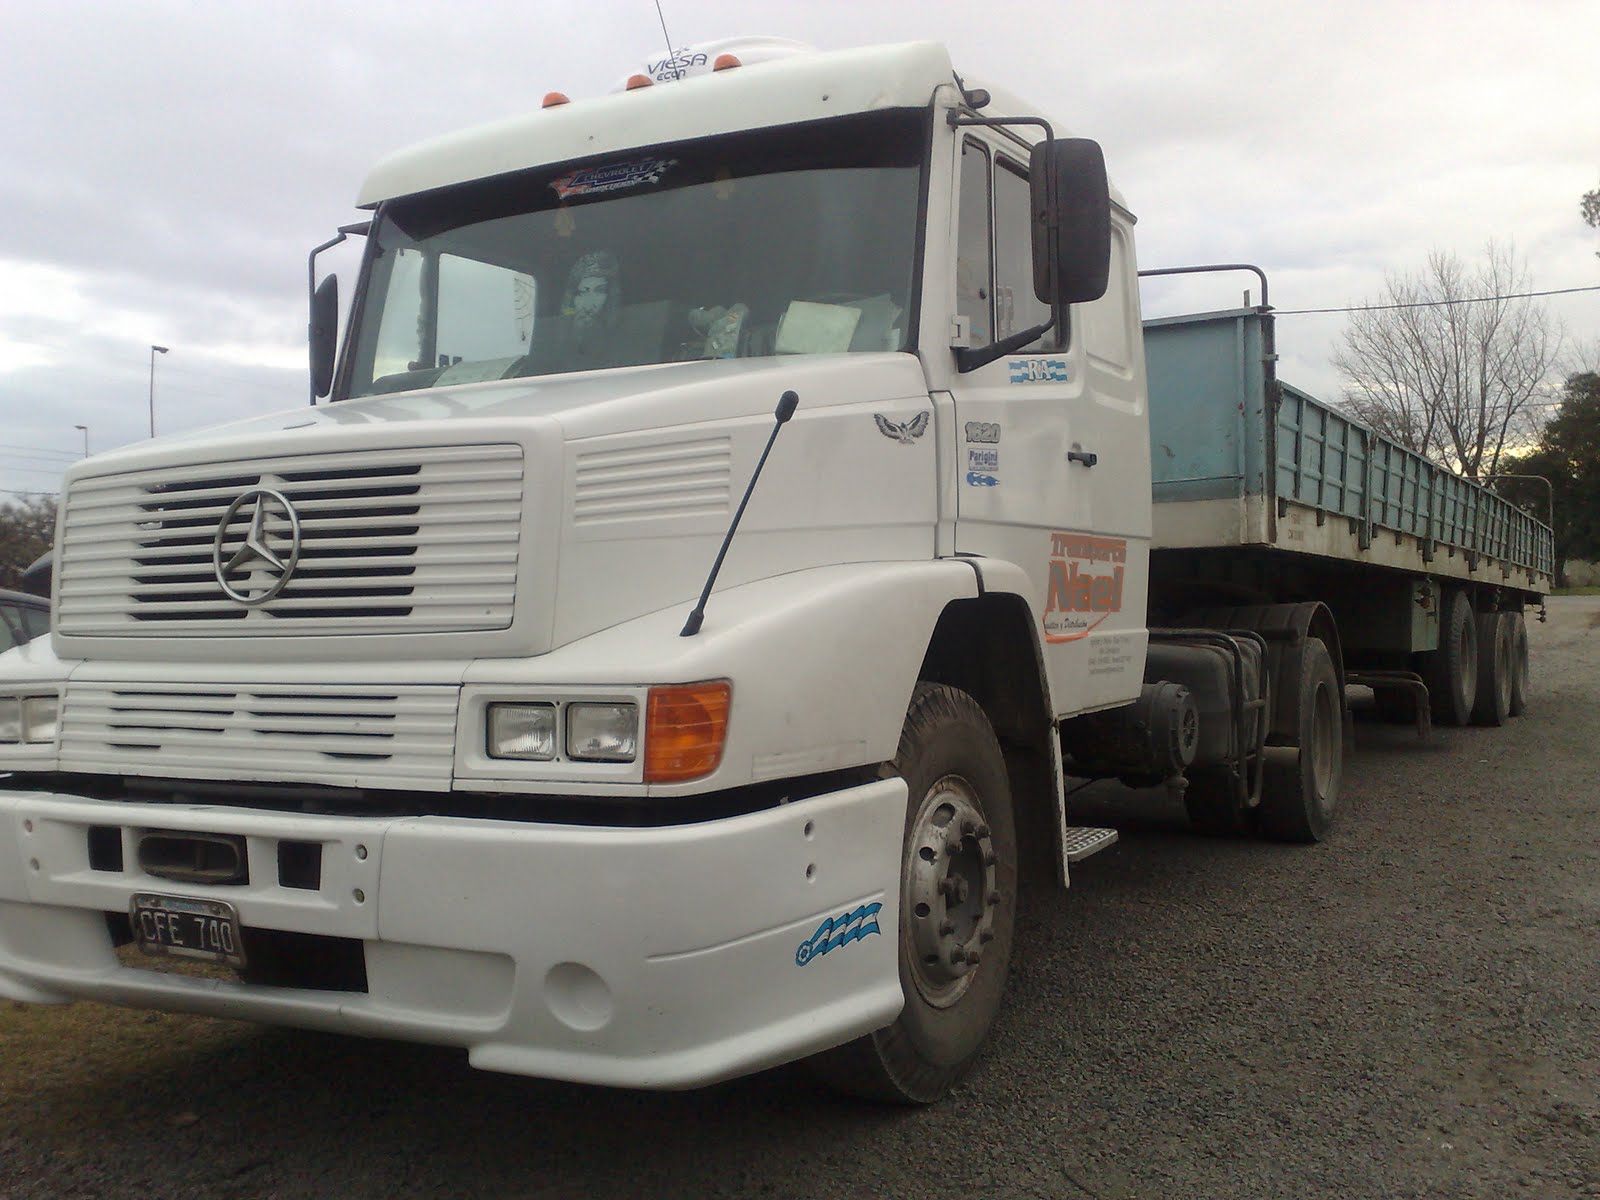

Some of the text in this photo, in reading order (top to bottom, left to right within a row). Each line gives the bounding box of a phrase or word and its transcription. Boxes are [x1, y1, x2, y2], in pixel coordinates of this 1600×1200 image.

[647, 53, 708, 74] VIESA
[584, 165, 645, 181] CHEVROLET
[1027, 360, 1051, 381] RA
[1047, 560, 1124, 612] Nael
[140, 911, 234, 953] CFE 740
